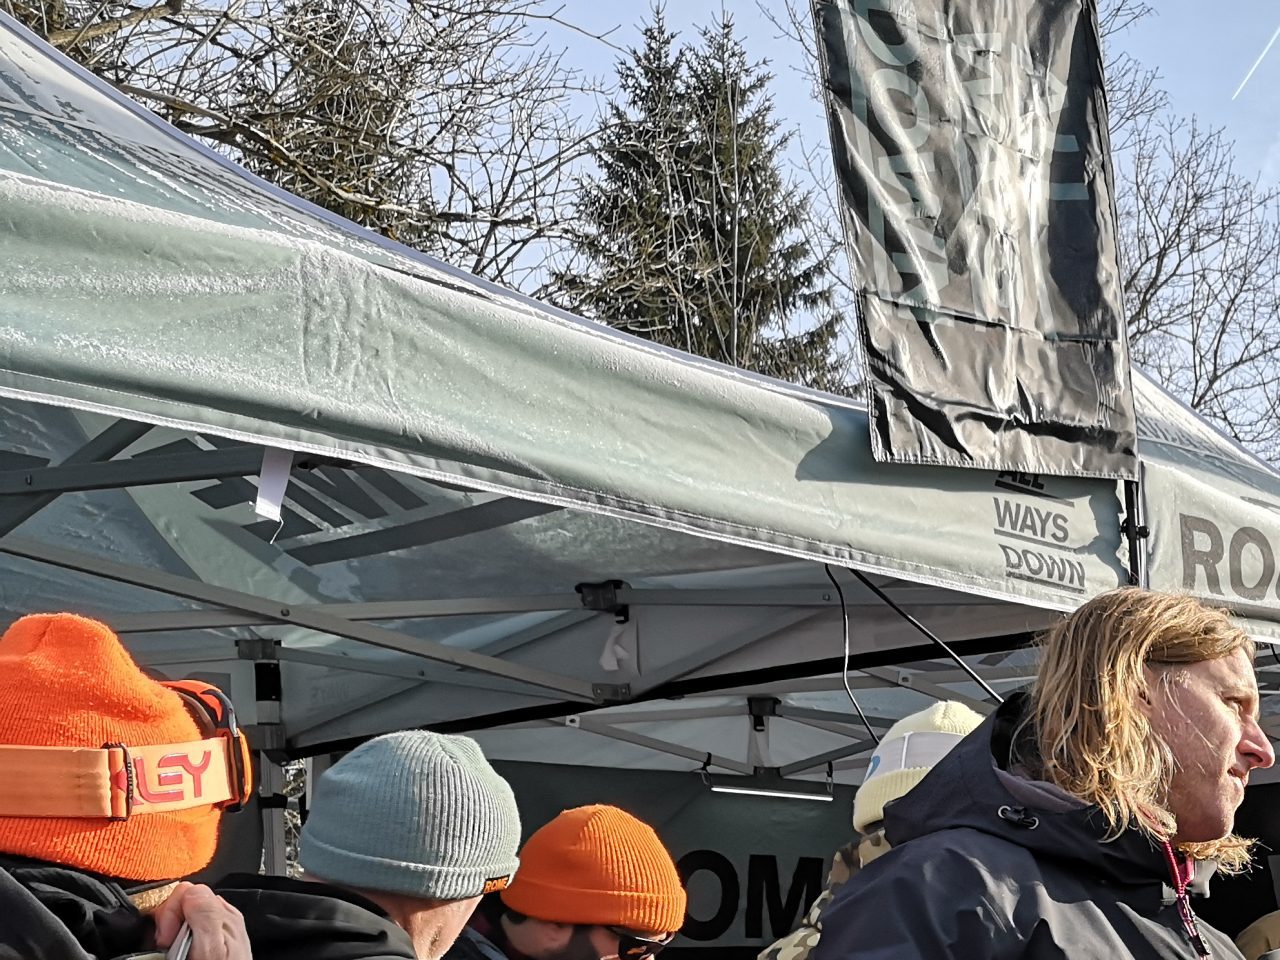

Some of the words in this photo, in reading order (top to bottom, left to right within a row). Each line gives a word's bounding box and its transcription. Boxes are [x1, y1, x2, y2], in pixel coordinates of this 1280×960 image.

[993, 497, 1069, 543] WAYS
[998, 544, 1086, 589] DOWN
[484, 877, 509, 893] ROME
[676, 849, 825, 942] OM
